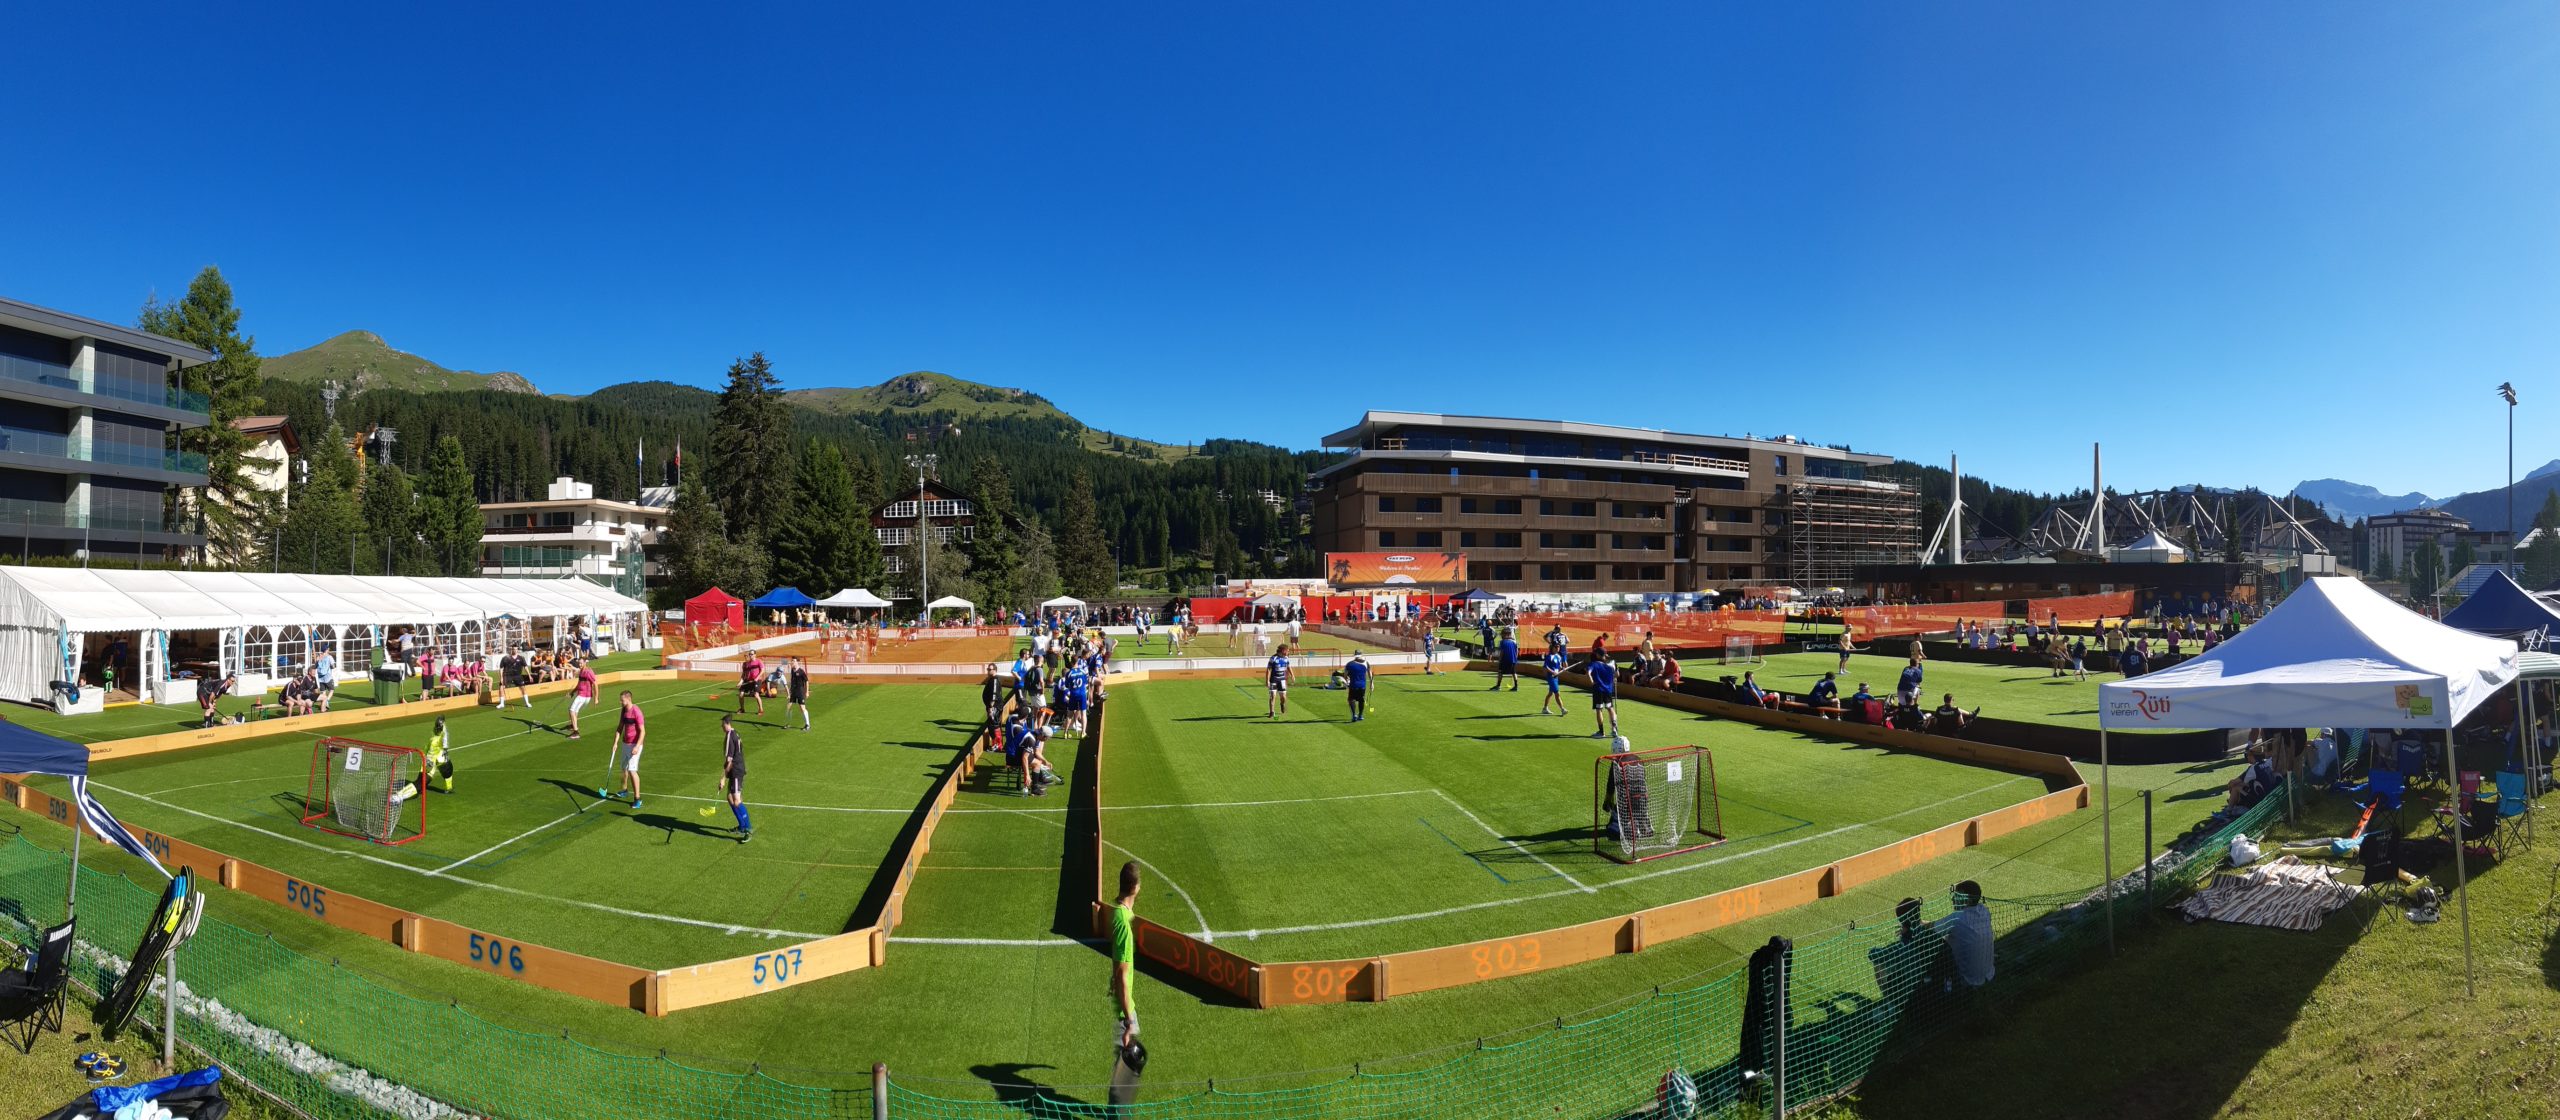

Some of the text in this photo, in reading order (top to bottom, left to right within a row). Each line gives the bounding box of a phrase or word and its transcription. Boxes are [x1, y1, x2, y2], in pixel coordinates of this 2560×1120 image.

[2132, 690, 2170, 720] Rüti
[350, 752, 359, 765] 5
[2018, 799, 2048, 824] 806
[144, 831, 170, 861] 504
[1900, 834, 1937, 867] 805
[286, 878, 326, 916] 505
[1717, 887, 1761, 924] 804
[468, 933, 525, 972] 506
[753, 948, 803, 986] 507
[1471, 939, 1542, 979] 803
[1207, 950, 1249, 998] 801
[1292, 965, 1359, 999] 802
